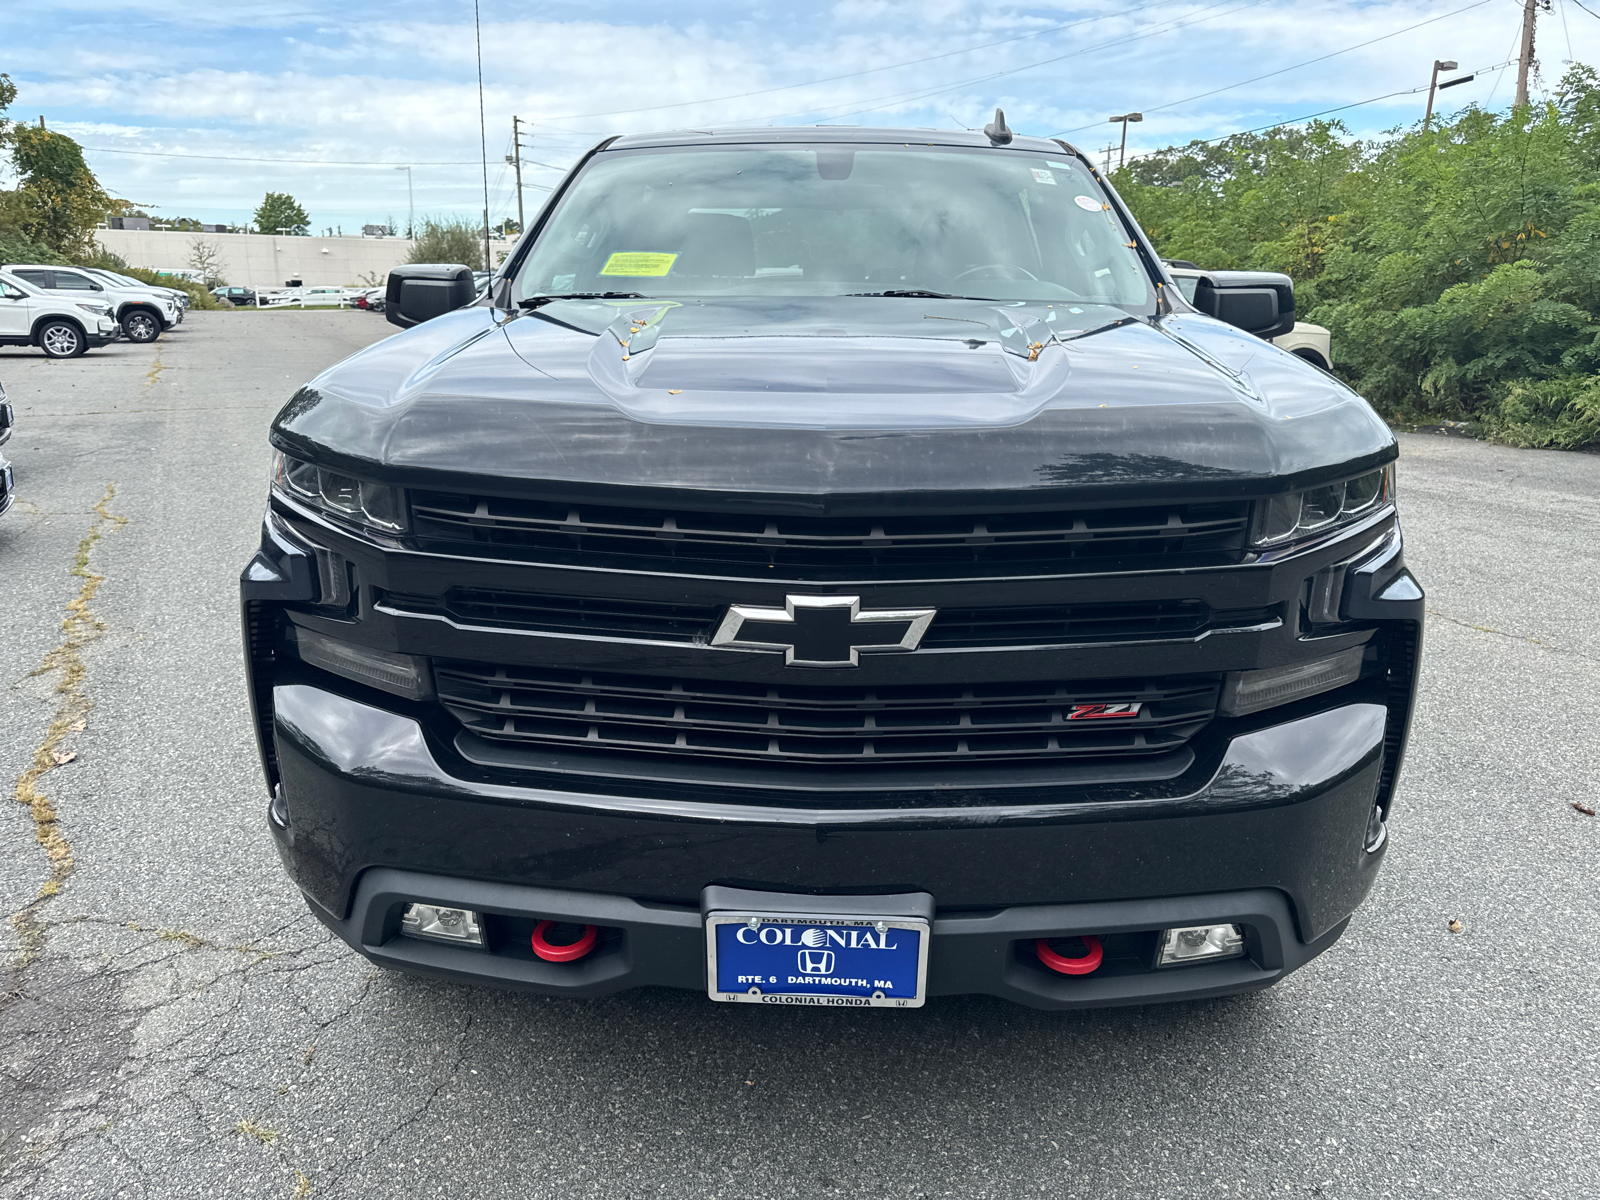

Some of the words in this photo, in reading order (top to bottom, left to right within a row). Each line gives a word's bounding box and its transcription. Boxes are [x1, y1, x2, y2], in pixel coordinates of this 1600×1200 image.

[736, 927, 897, 950] COLONIAL
[788, 976, 870, 988] DARTMOUTH,
[874, 980, 893, 989] MA
[762, 996, 823, 1004] COLONIAL
[827, 998, 871, 1006] HONDA
